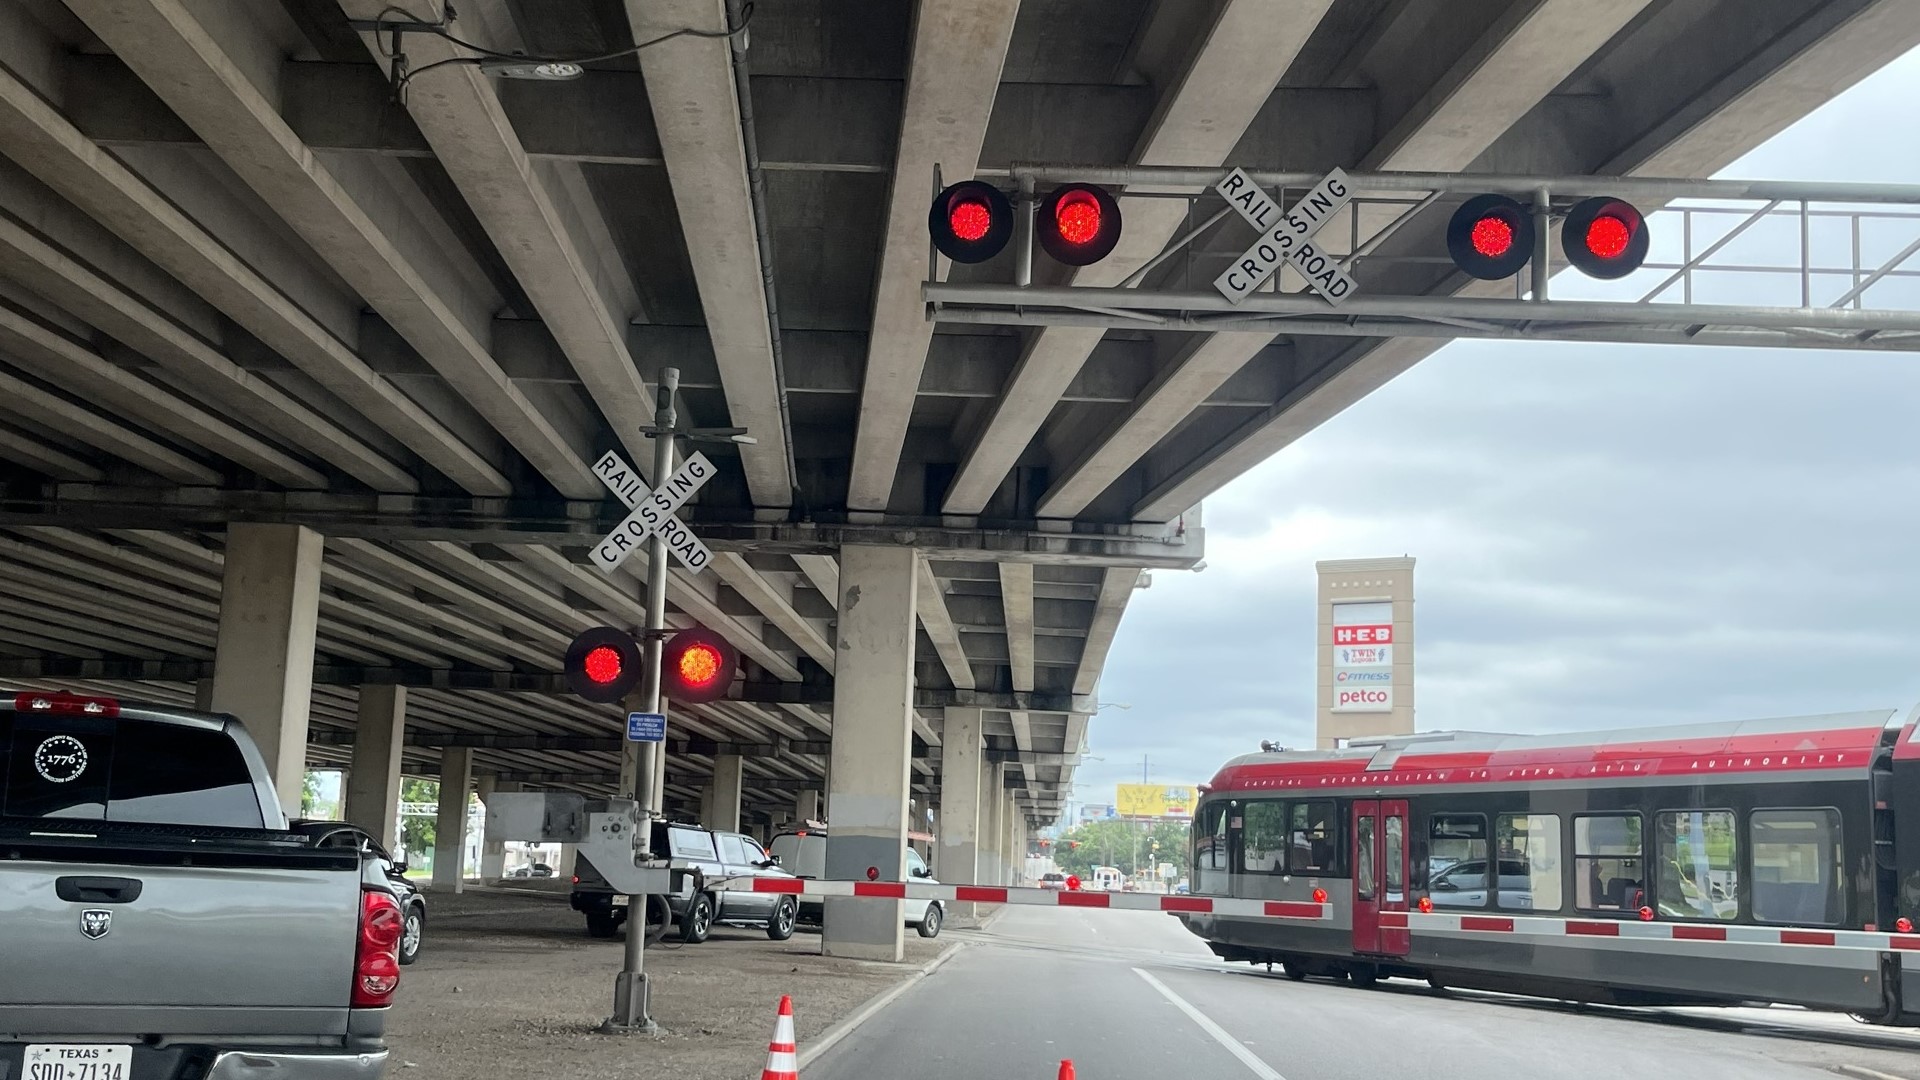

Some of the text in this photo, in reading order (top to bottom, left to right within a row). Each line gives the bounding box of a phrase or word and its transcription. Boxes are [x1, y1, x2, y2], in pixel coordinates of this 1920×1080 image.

[1223, 174, 1349, 298] RAIL ROAD
[1227, 179, 1347, 292] CROSSING
[597, 456, 707, 567] RAIL ROAD
[600, 461, 705, 562] CROSSING
[1351, 648, 1376, 658] TWIN
[1340, 689, 1388, 706] petco
[47, 754, 76, 765] 1776
[1244, 779, 1302, 787] CAPITAL
[1320, 773, 1446, 784] METROPOLITAN
[1691, 754, 1844, 769] AUTHORITY
[59, 1049, 99, 1058] TEXAS
